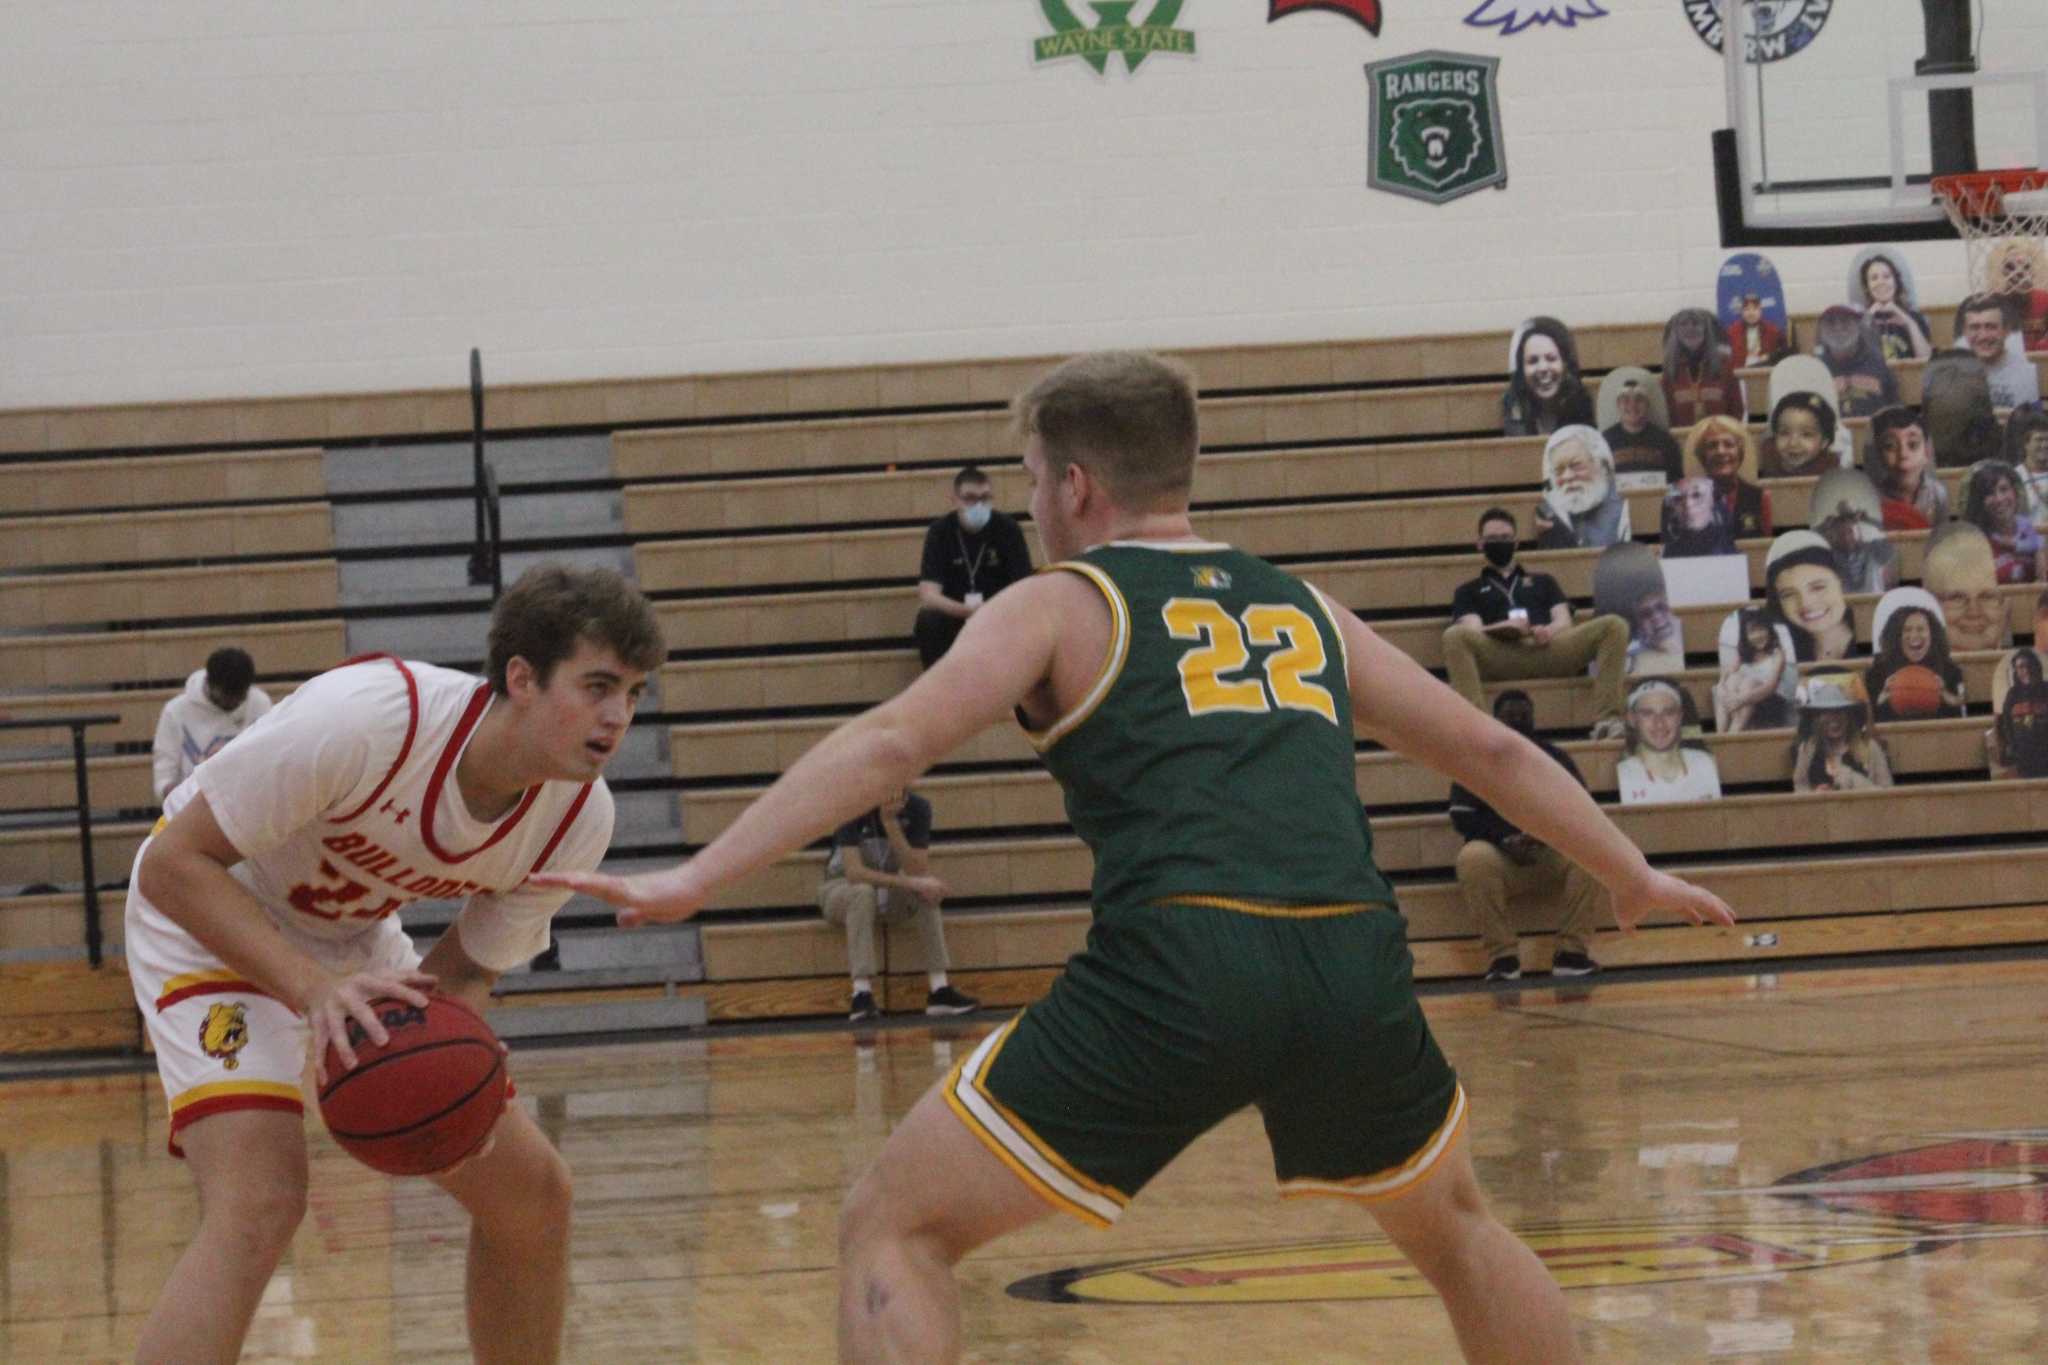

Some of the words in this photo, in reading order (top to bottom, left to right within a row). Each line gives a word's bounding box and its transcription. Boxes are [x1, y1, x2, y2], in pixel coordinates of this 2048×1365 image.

[1040, 30, 1118, 55] WAYNE
[1123, 30, 1189, 50] STATE
[1385, 68, 1480, 100] RANGERS
[1161, 597, 1339, 727] 22
